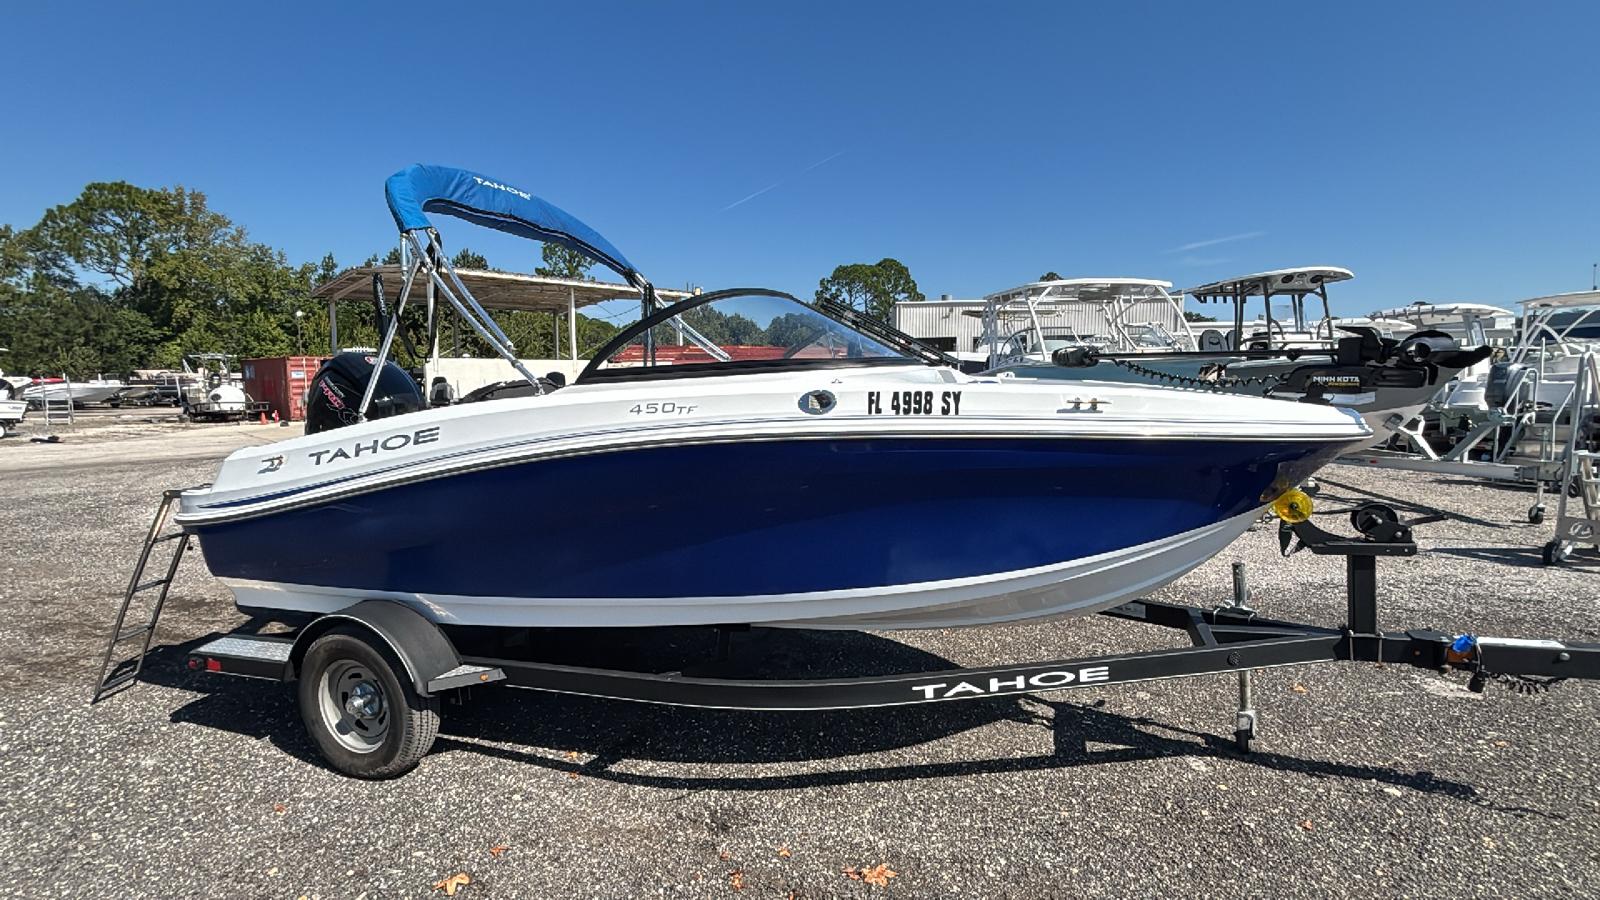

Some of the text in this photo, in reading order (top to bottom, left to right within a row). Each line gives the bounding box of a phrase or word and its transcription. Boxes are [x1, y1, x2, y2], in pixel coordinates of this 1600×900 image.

[473, 176, 531, 200] TAHOE
[868, 391, 962, 415] FL 4998 SY
[308, 426, 440, 466] TAHOE
[912, 666, 1110, 699] TAHOE
